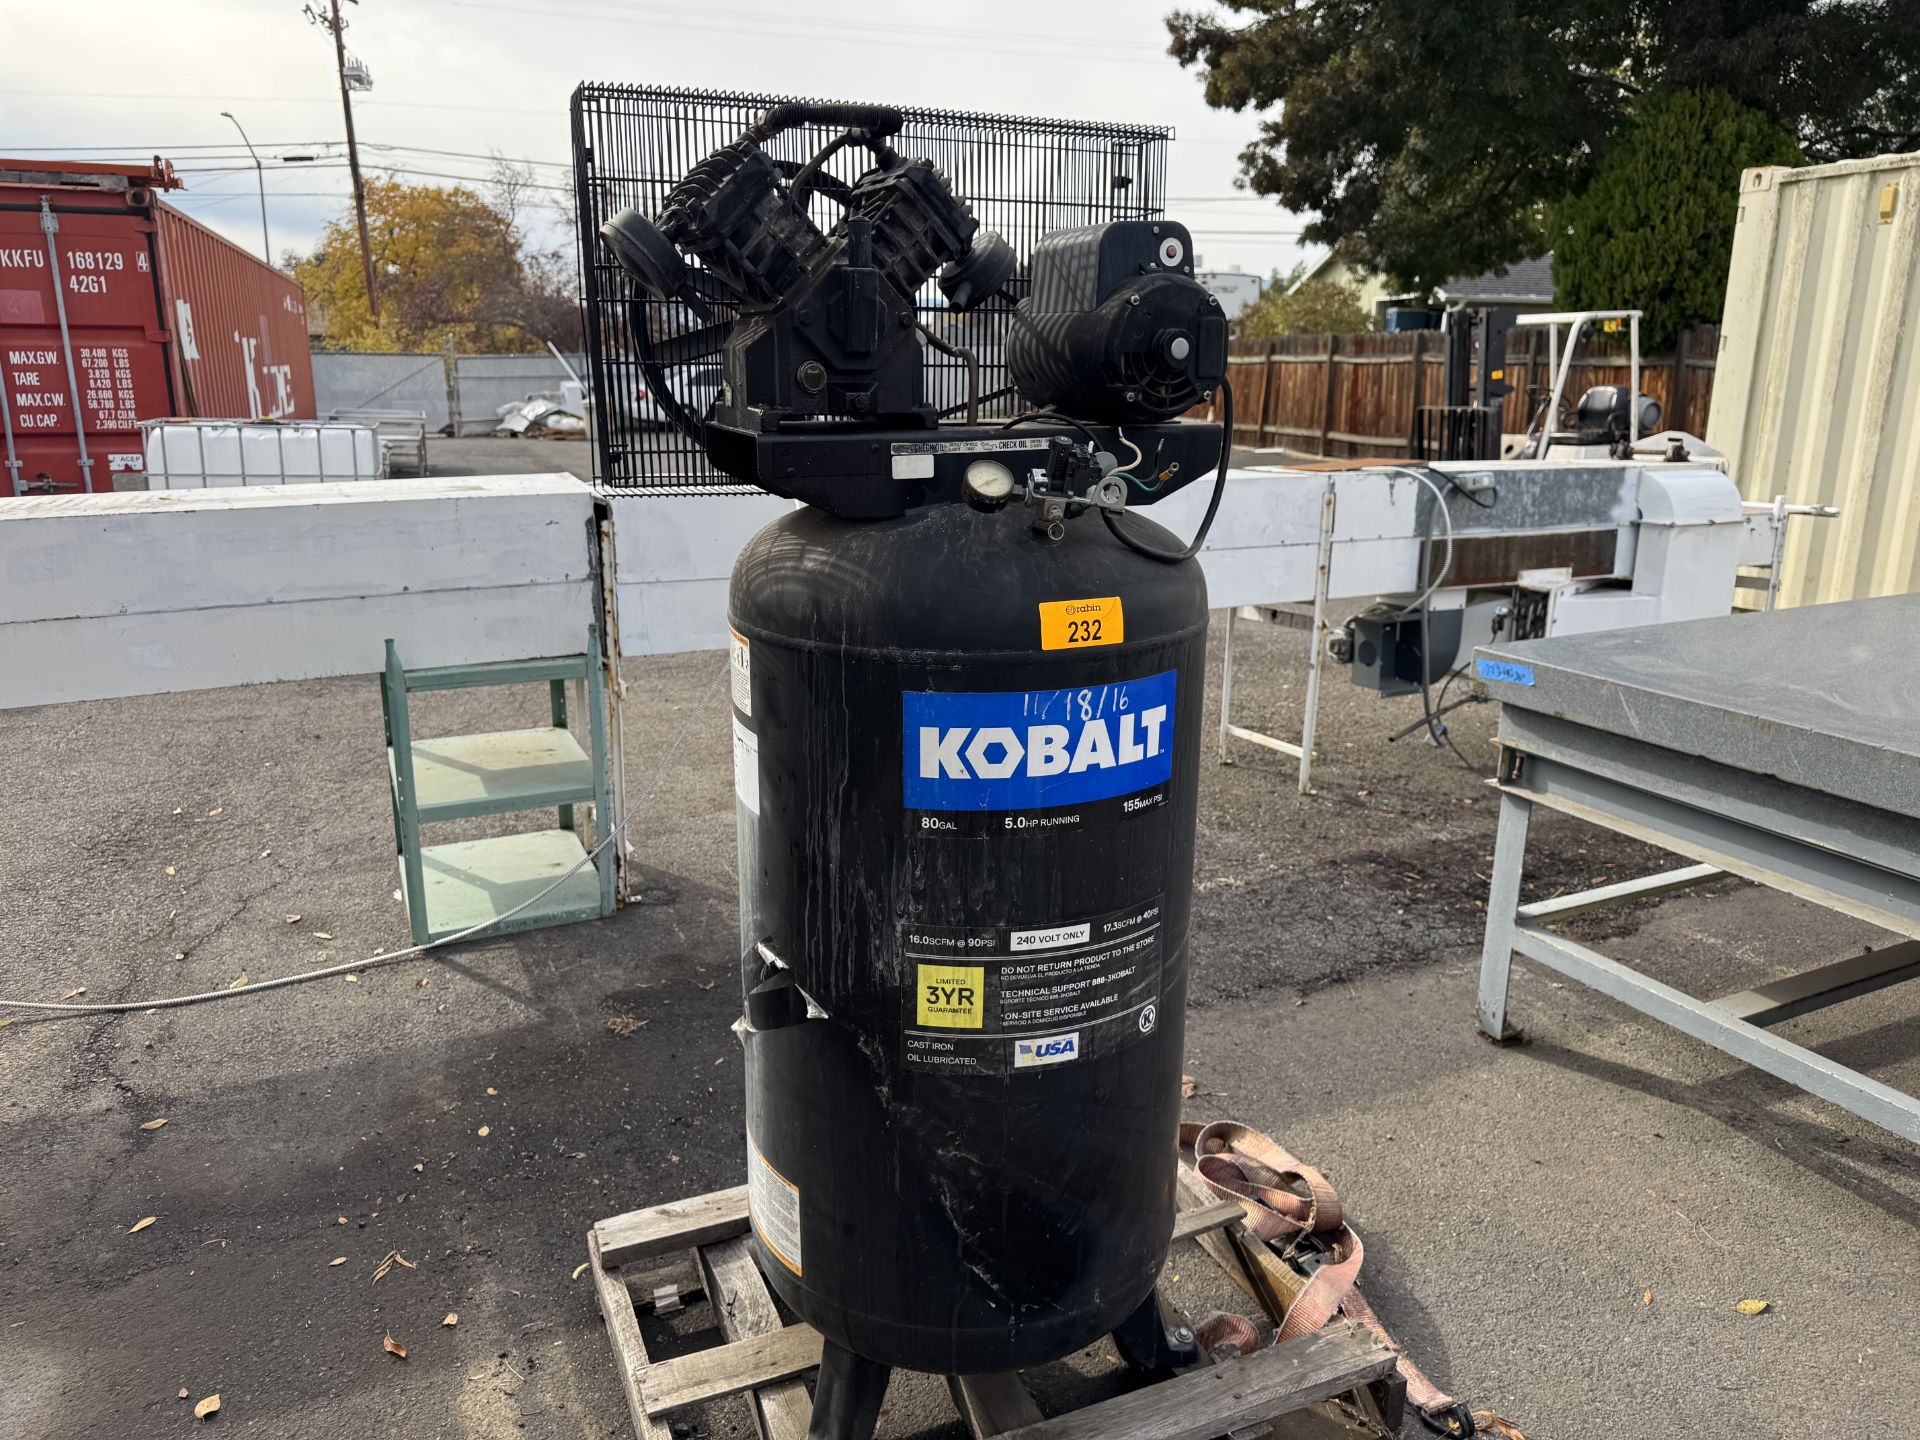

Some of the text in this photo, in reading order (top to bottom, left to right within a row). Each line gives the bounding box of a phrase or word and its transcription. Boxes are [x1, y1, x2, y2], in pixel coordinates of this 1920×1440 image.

[0, 249, 148, 270] KKFU 168129 4
[70, 275, 107, 293] 42G1
[80, 348, 129, 358] 30.480 KGS
[82, 358, 130, 368] 67.200 LBS
[13, 372, 40, 386] TARE
[88, 368, 132, 378] 3.820 KGS
[117, 378, 133, 389] LBS
[118, 389, 135, 399] KGS
[120, 399, 136, 409] LBS
[98, 410, 116, 419] 67.7
[998, 441, 1017, 450] CHECK
[1018, 440, 1028, 449] OIL
[1076, 604, 1101, 613] rabin
[1068, 619, 1102, 643] 232
[920, 704, 1167, 779] KOBALT
[1154, 794, 1163, 804] PSI
[921, 817, 957, 830] 80GAL
[1005, 815, 1080, 829] 5.0HP RUNNING
[909, 935, 995, 948] 16.0SCFM @ 90PSI
[1016, 930, 1085, 945] 240 VOLT ONLY
[1001, 935, 1154, 975] DO NOT RETURN PRODUCT TO THE STORE
[1044, 969, 1072, 977] PRODUCTO
[1001, 965, 1136, 998] TECHNICAL SUPPORT 888-3KOBALT
[926, 986, 975, 1006] 3YR
[927, 1006, 972, 1015] GUARANTEE
[1043, 1004, 1078, 1016] SERVICE
[1080, 993, 1118, 1011] AVAILABLE
[907, 1040, 954, 1051] CAST IRON
[1035, 1040, 1074, 1057] USA
[907, 1053, 977, 1065] OIL LUBRICATED
